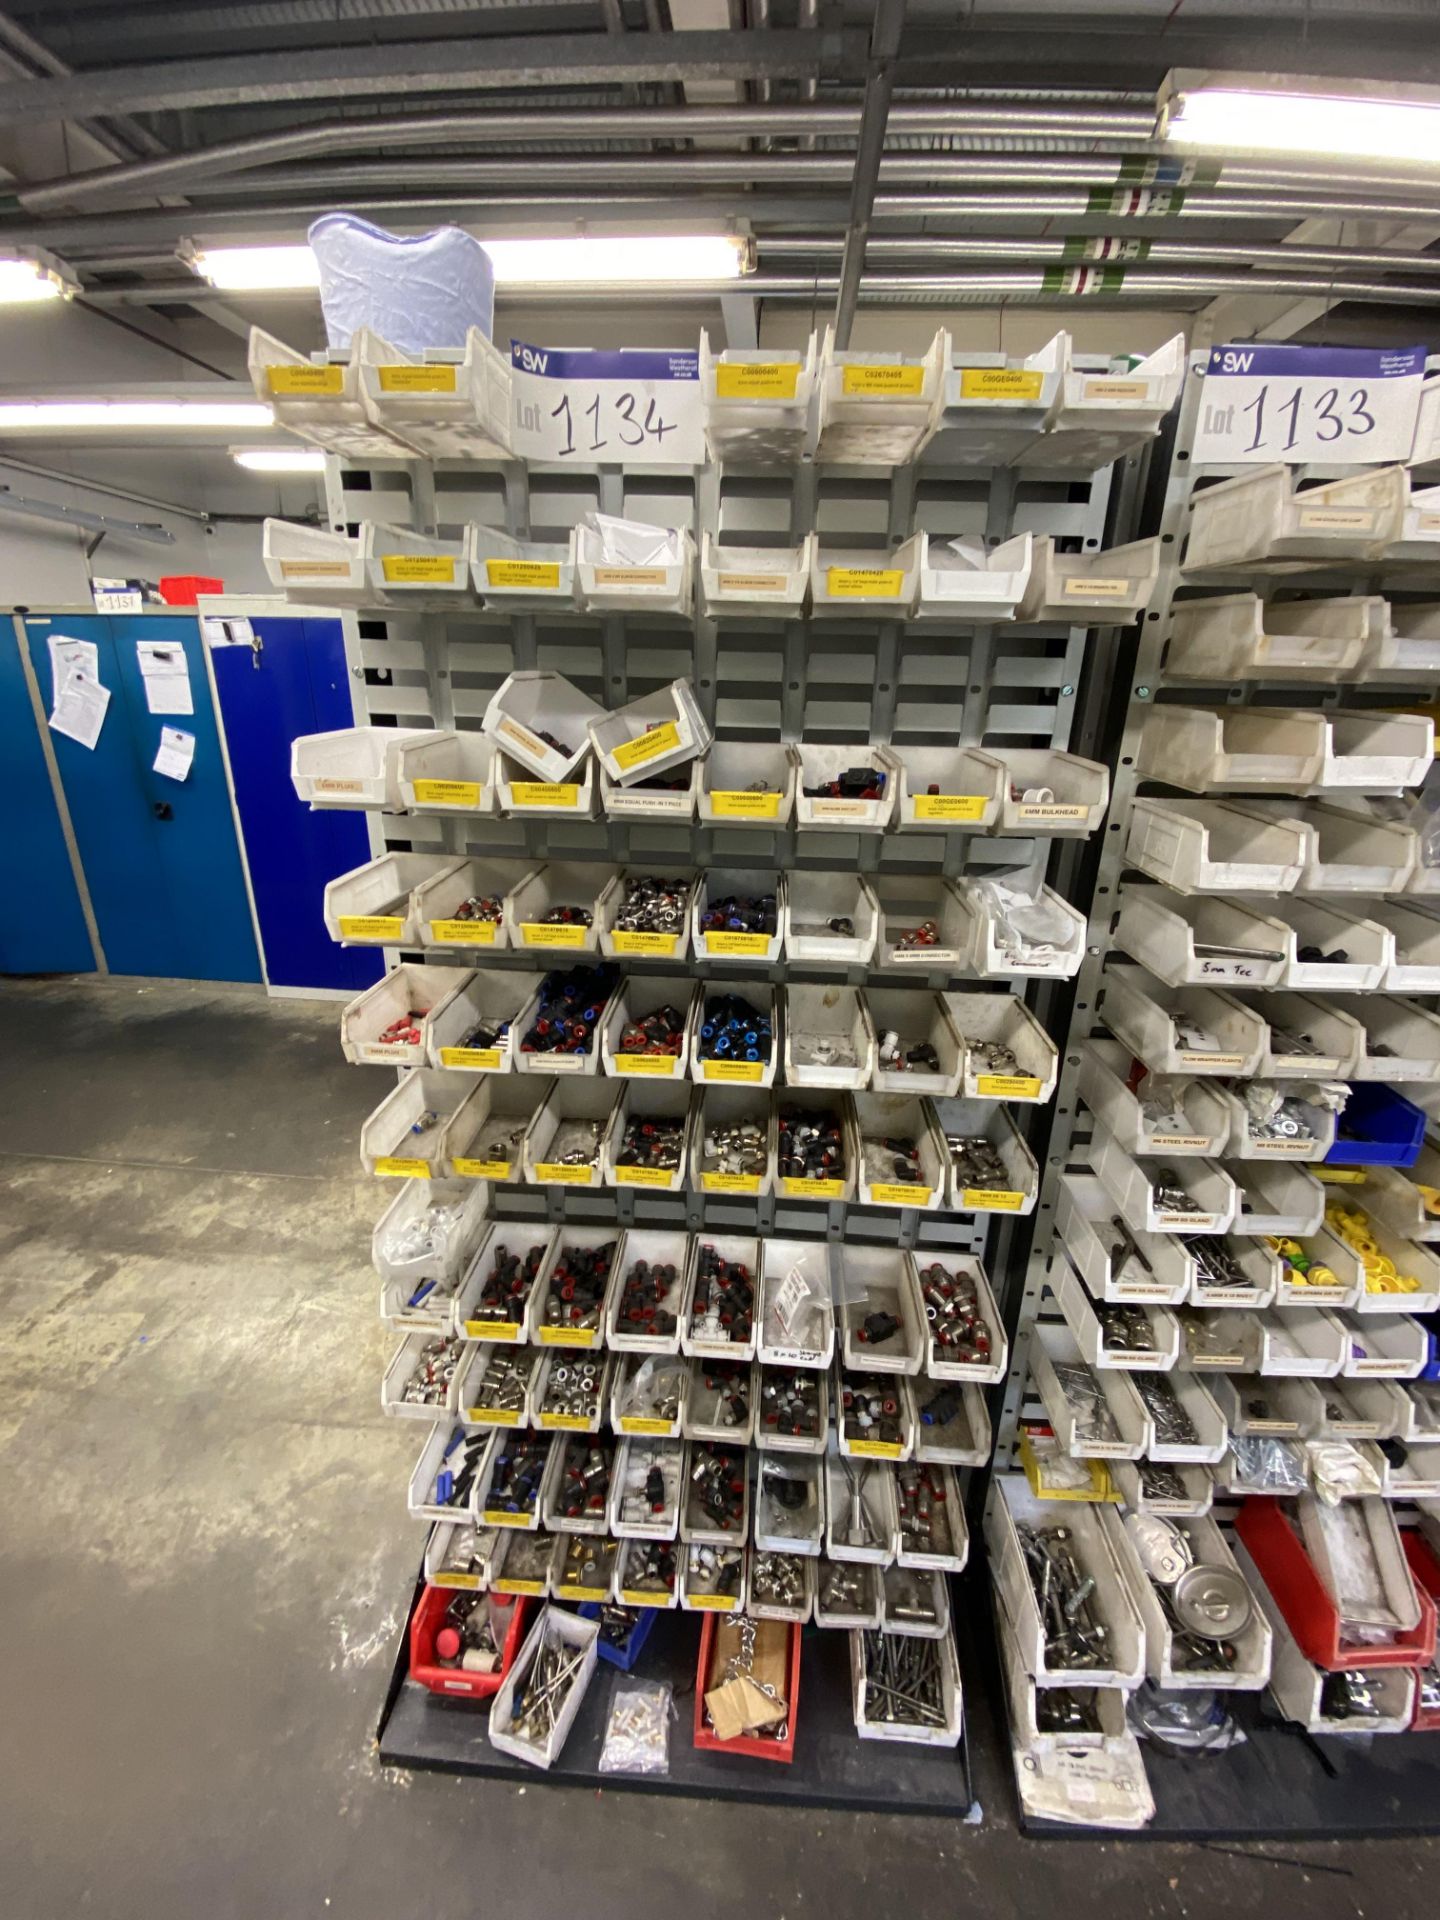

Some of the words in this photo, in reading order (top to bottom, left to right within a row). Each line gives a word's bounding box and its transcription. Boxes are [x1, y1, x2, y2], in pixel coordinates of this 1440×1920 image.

[522, 348, 549, 374] SW
[1222, 351, 1255, 373] SW
[517, 398, 541, 433] Lot
[551, 392, 678, 456] 1134
[1203, 404, 1235, 435] Lot
[1243, 384, 1376, 453] 1133
[1041, 809, 1079, 817] BULKHEAD
